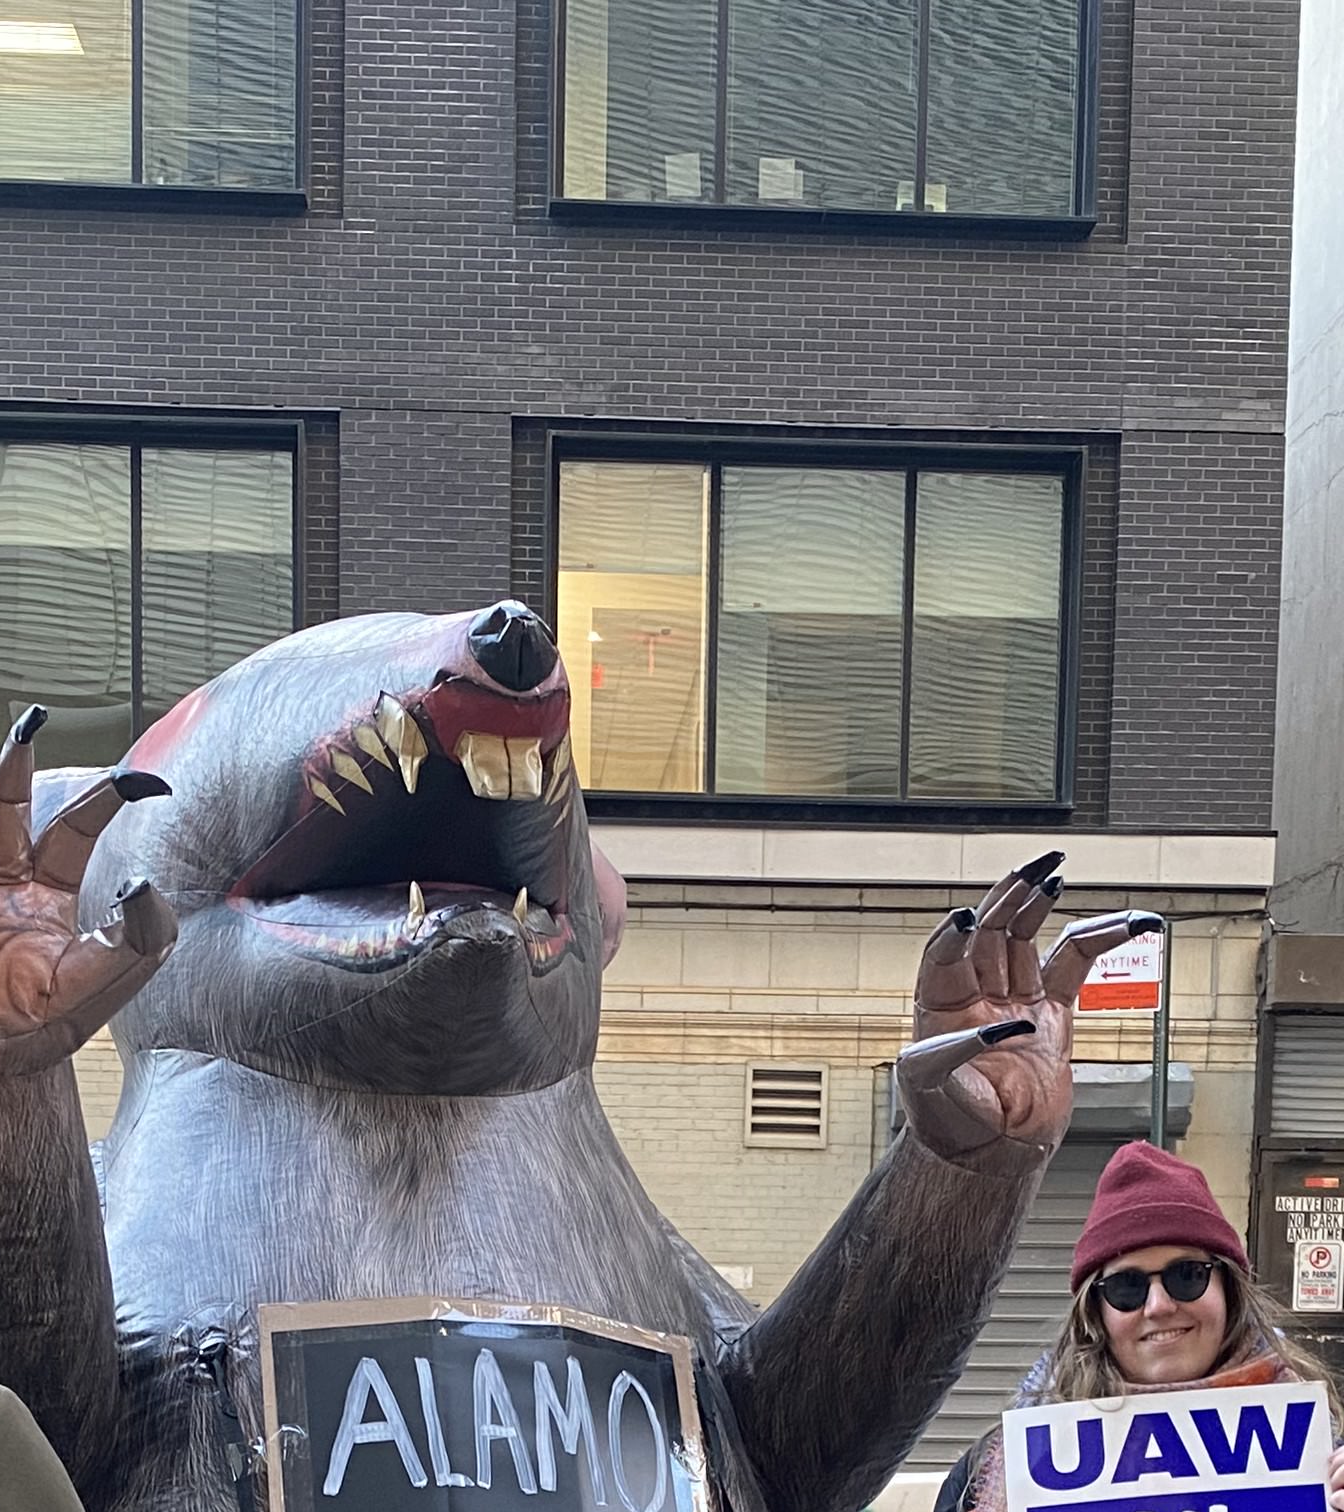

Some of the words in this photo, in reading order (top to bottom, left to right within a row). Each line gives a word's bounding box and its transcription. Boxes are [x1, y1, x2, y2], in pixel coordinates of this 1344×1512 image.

[1095, 956, 1149, 968] NYTIME
[1276, 1196, 1321, 1211] ACTIVE
[1288, 1213, 1304, 1228] NO
[1026, 1401, 1316, 1491] UAW
